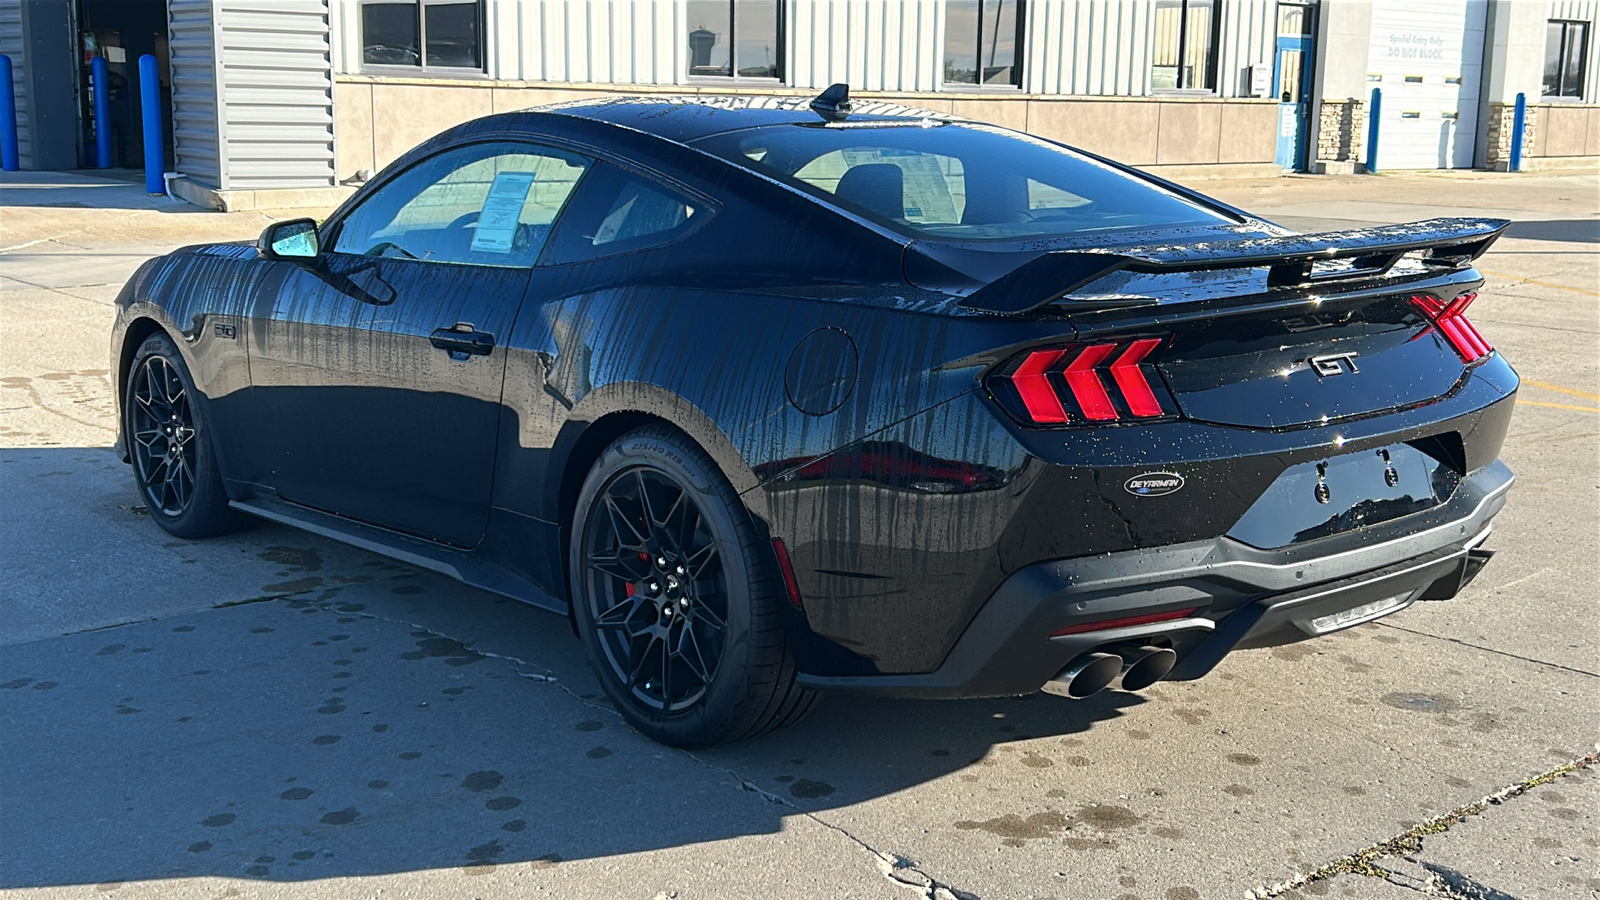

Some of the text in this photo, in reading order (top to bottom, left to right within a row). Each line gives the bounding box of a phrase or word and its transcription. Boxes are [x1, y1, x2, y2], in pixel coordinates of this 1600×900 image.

[1389, 34, 1443, 47] Special Entry Only
[1388, 47, 1442, 59] DO NOT BLOCK
[1308, 351, 1359, 377] GT
[1130, 479, 1179, 488] DEYARMAN
